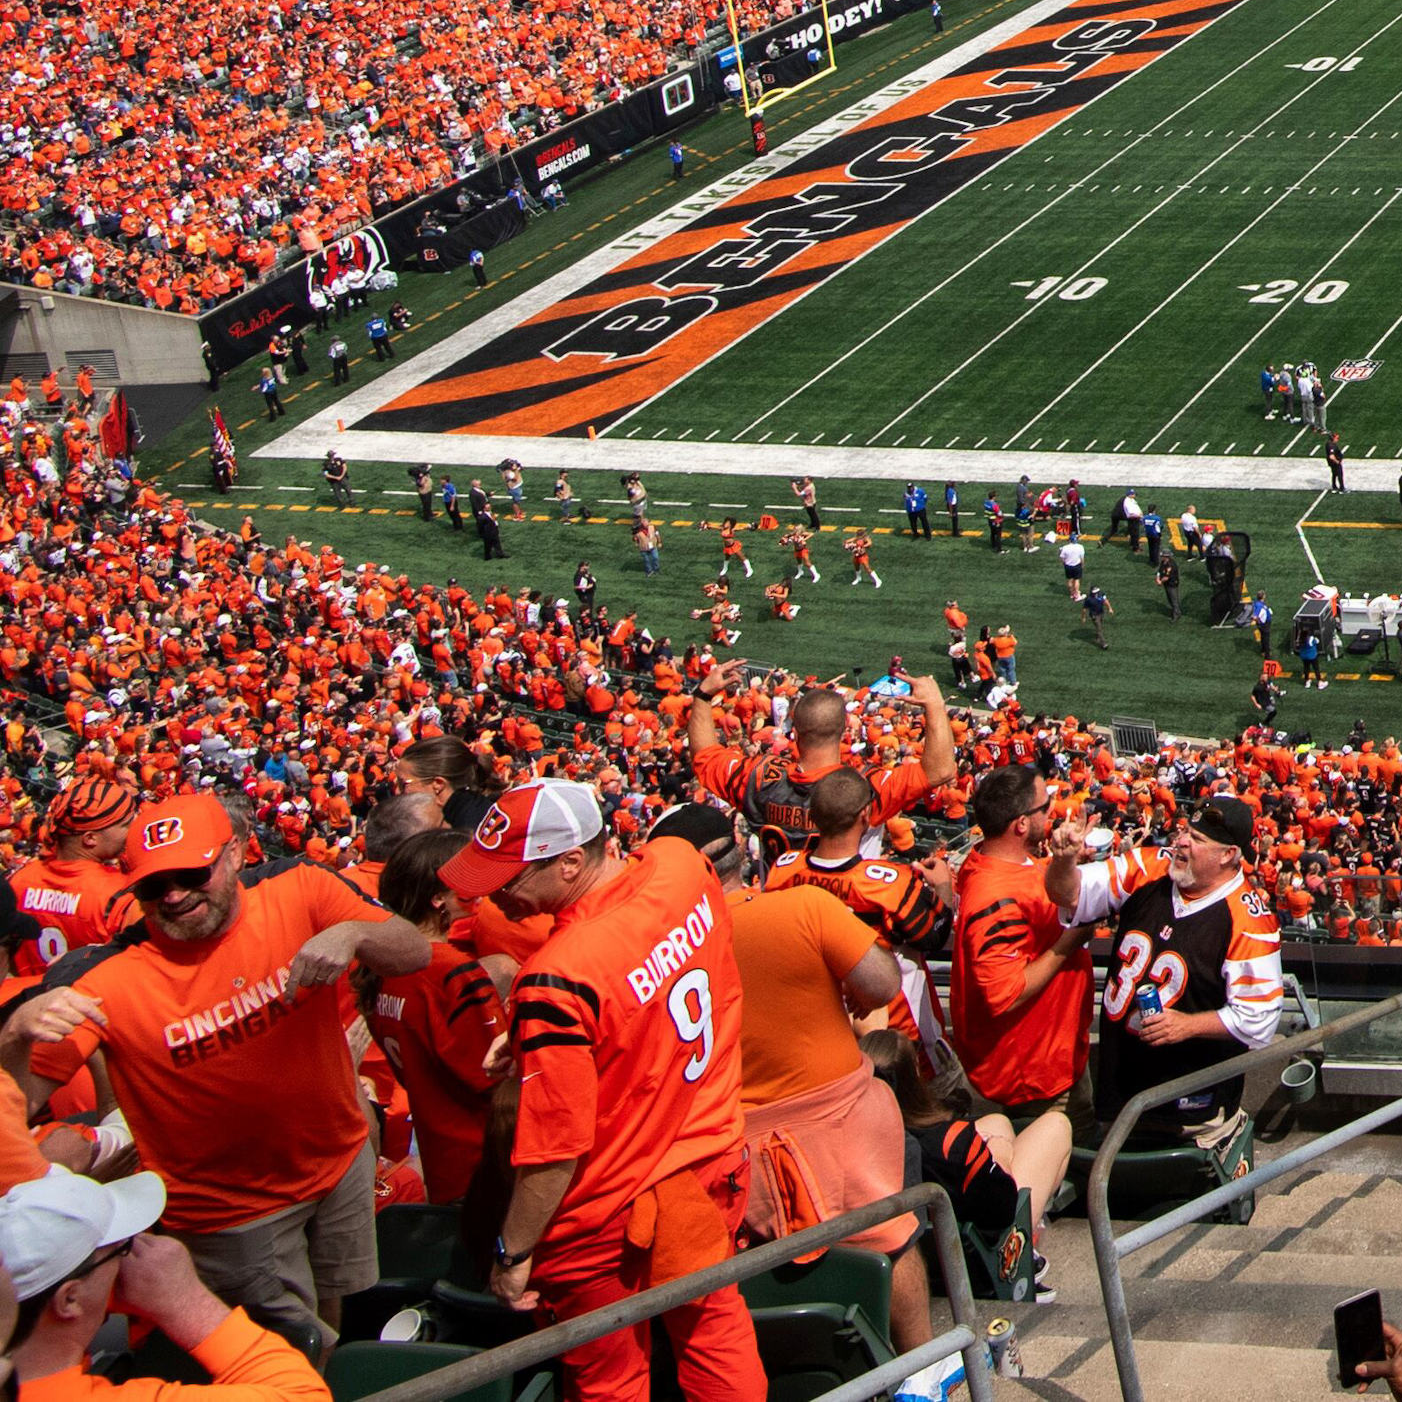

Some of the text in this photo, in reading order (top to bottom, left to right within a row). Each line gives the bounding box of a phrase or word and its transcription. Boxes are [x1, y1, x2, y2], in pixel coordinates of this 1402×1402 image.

[537, 144, 590, 181] BENGALS.COM
[611, 78, 929, 250] IT TAKES ALL OF US
[541, 17, 1157, 363] BENGALS
[1025, 275, 1109, 301] 10
[1248, 279, 1350, 304] 20
[768, 803, 816, 830] HUBB
[24, 888, 82, 917] BURROW
[1241, 893, 1270, 917] 32
[626, 894, 714, 1005] BURROW
[164, 965, 292, 1048] CINCINNA
[377, 993, 405, 1021] RROW
[1104, 931, 1187, 1034] 32
[170, 998, 290, 1070] BENGA
[667, 967, 714, 1083] 9
